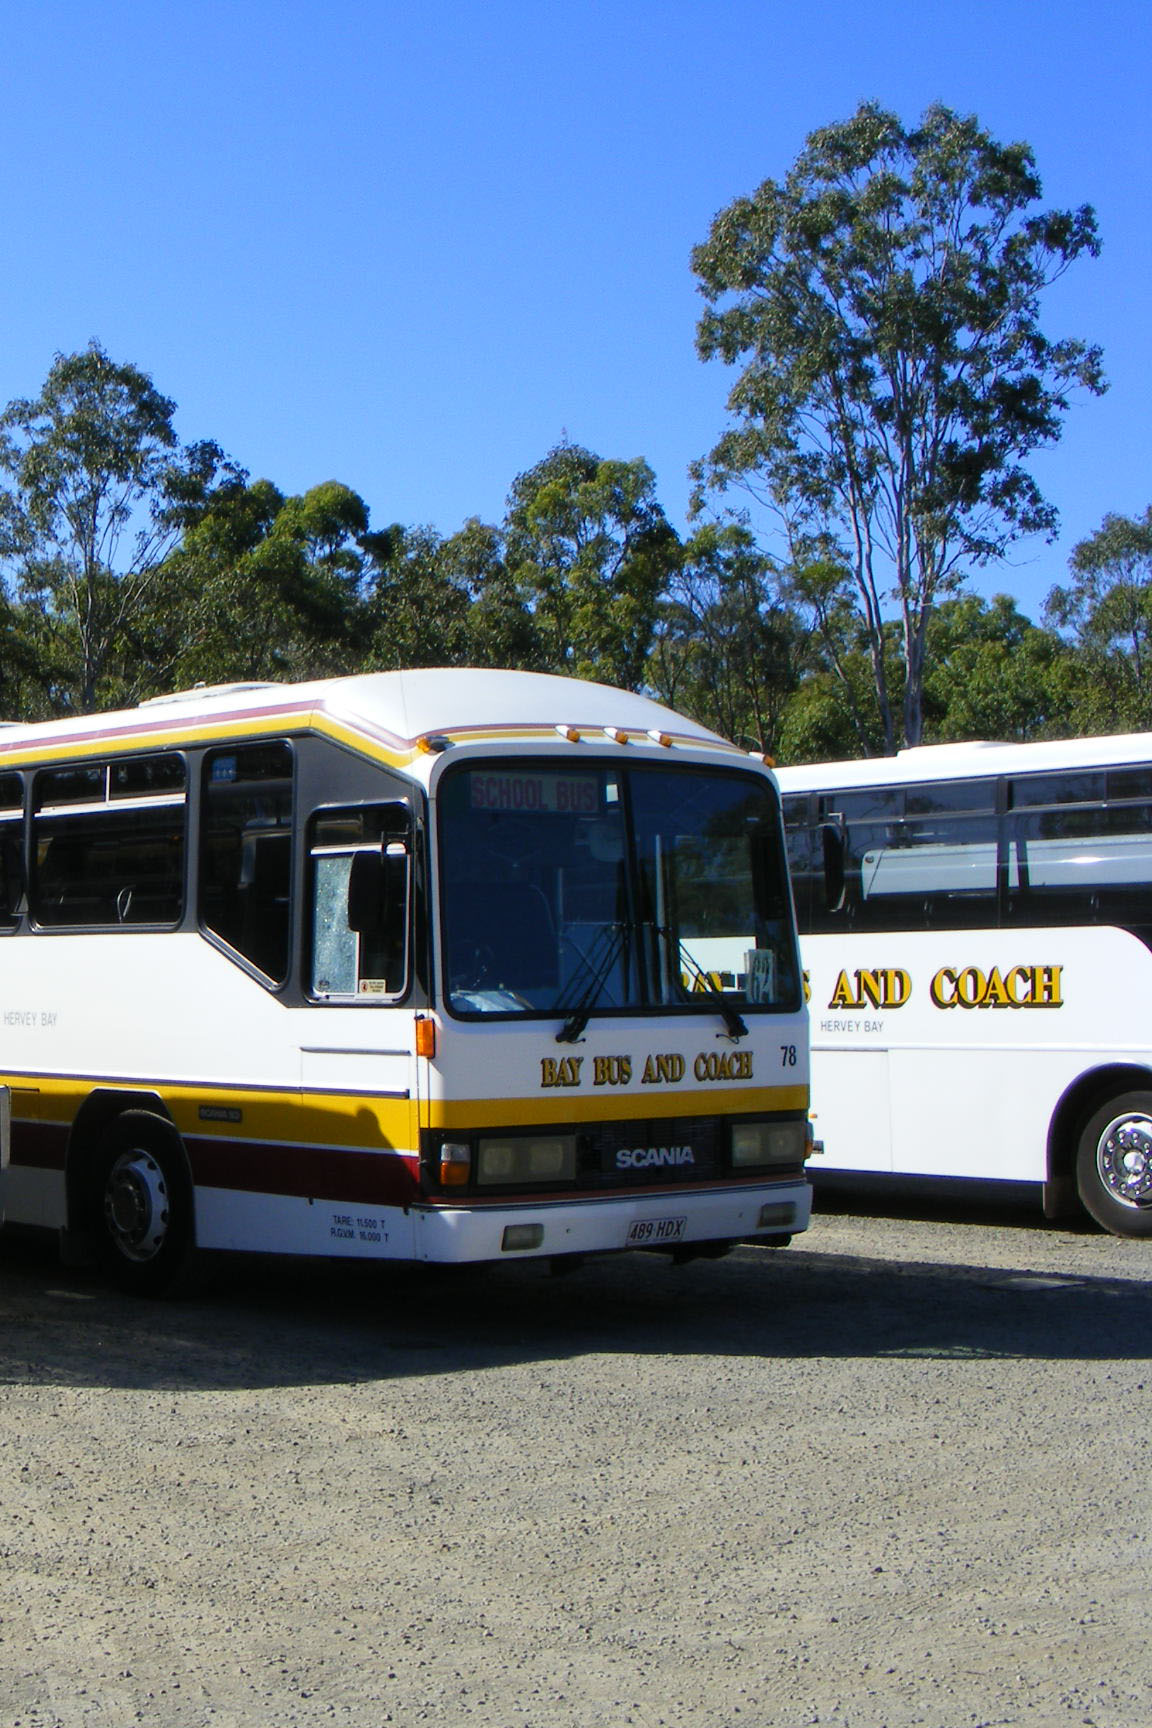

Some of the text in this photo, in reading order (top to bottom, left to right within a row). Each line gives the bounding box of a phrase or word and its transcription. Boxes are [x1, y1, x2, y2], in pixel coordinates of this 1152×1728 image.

[471, 776, 596, 810] SCHOOL BUS
[828, 968, 912, 1009] AND
[929, 964, 1064, 1009] COACH
[3, 1011, 57, 1026] HERVEY BAY
[820, 1020, 884, 1032] HERVEY BAY
[780, 1045, 797, 1067] 78
[540, 1050, 753, 1088] BAY BUS AND COACH
[616, 1146, 695, 1168] SCANIA
[381, 1220, 386, 1229] T
[384, 1233, 389, 1242] T
